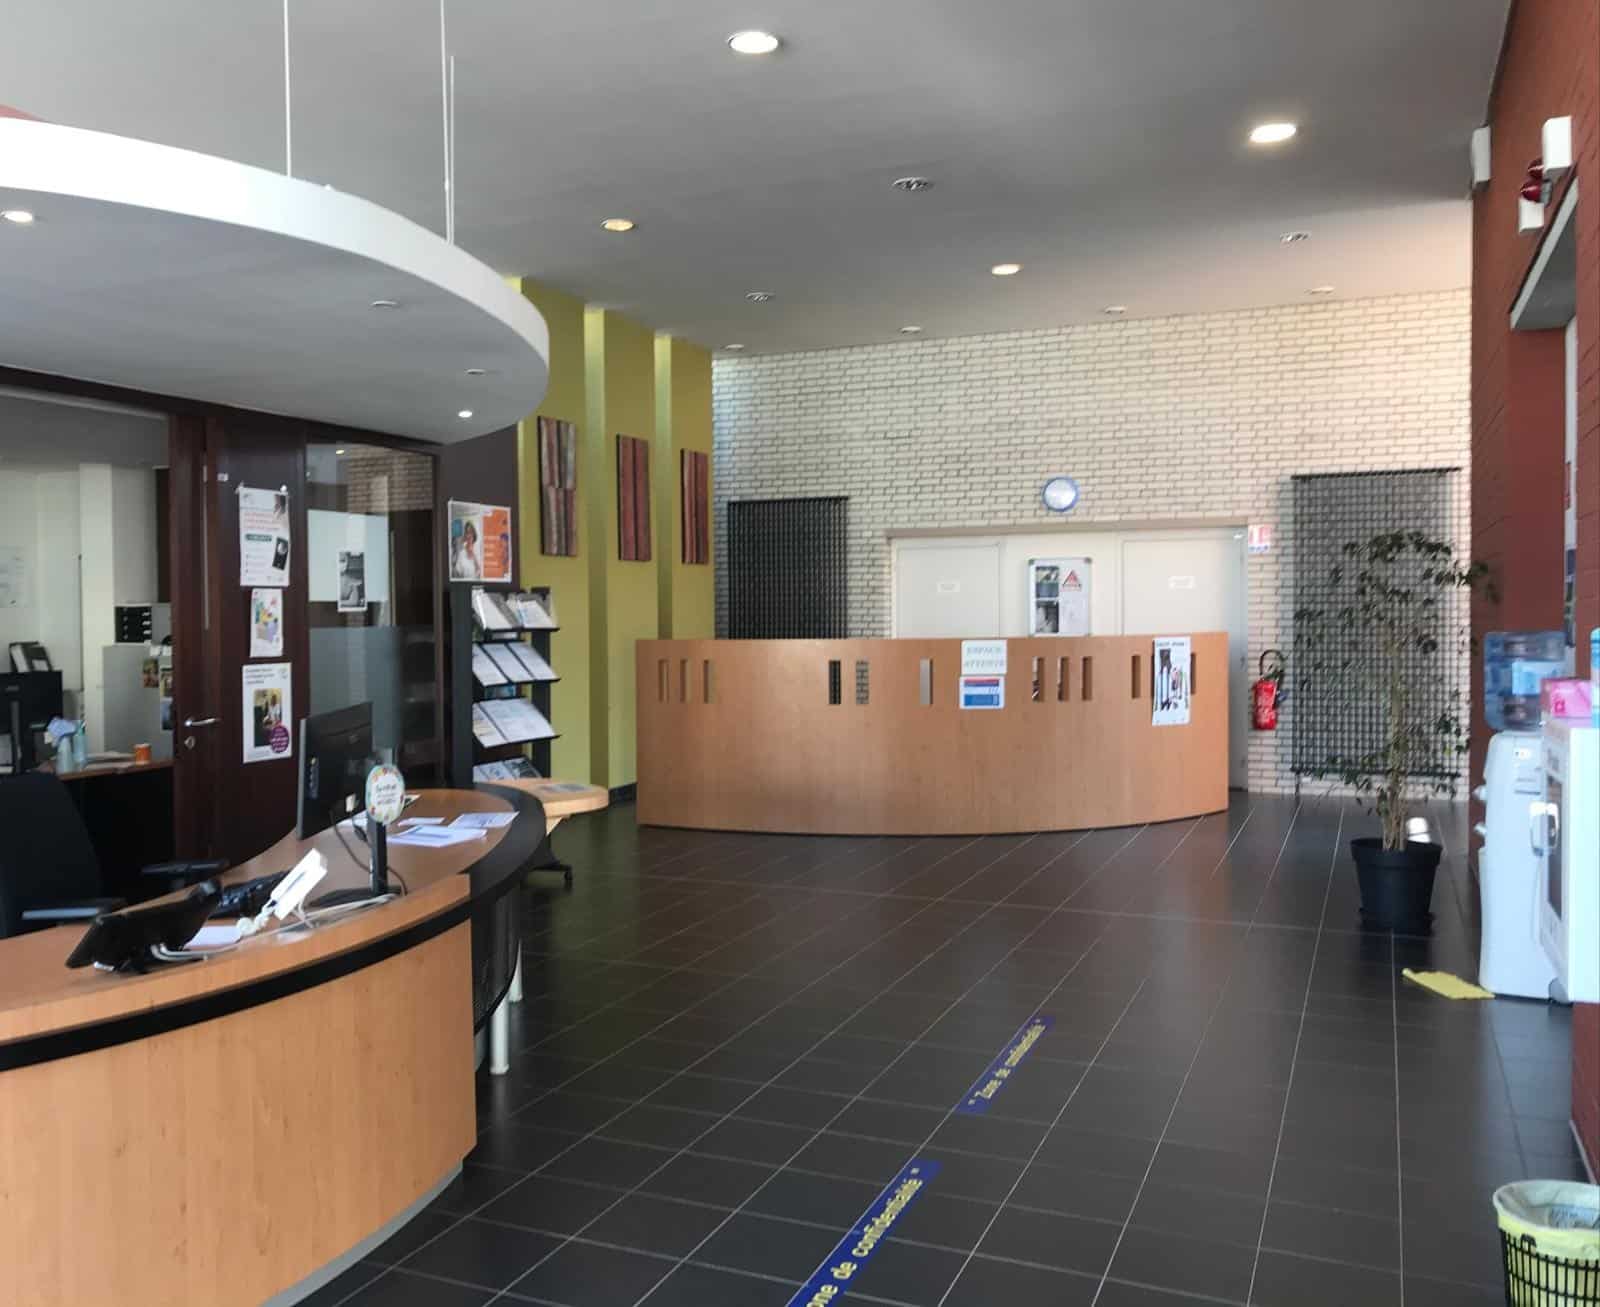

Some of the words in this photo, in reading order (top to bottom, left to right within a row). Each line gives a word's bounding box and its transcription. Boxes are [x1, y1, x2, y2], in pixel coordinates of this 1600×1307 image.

[805, 1284, 838, 1307] one
[830, 1262, 857, 1279] de
[852, 1178, 922, 1257] confidentialité
